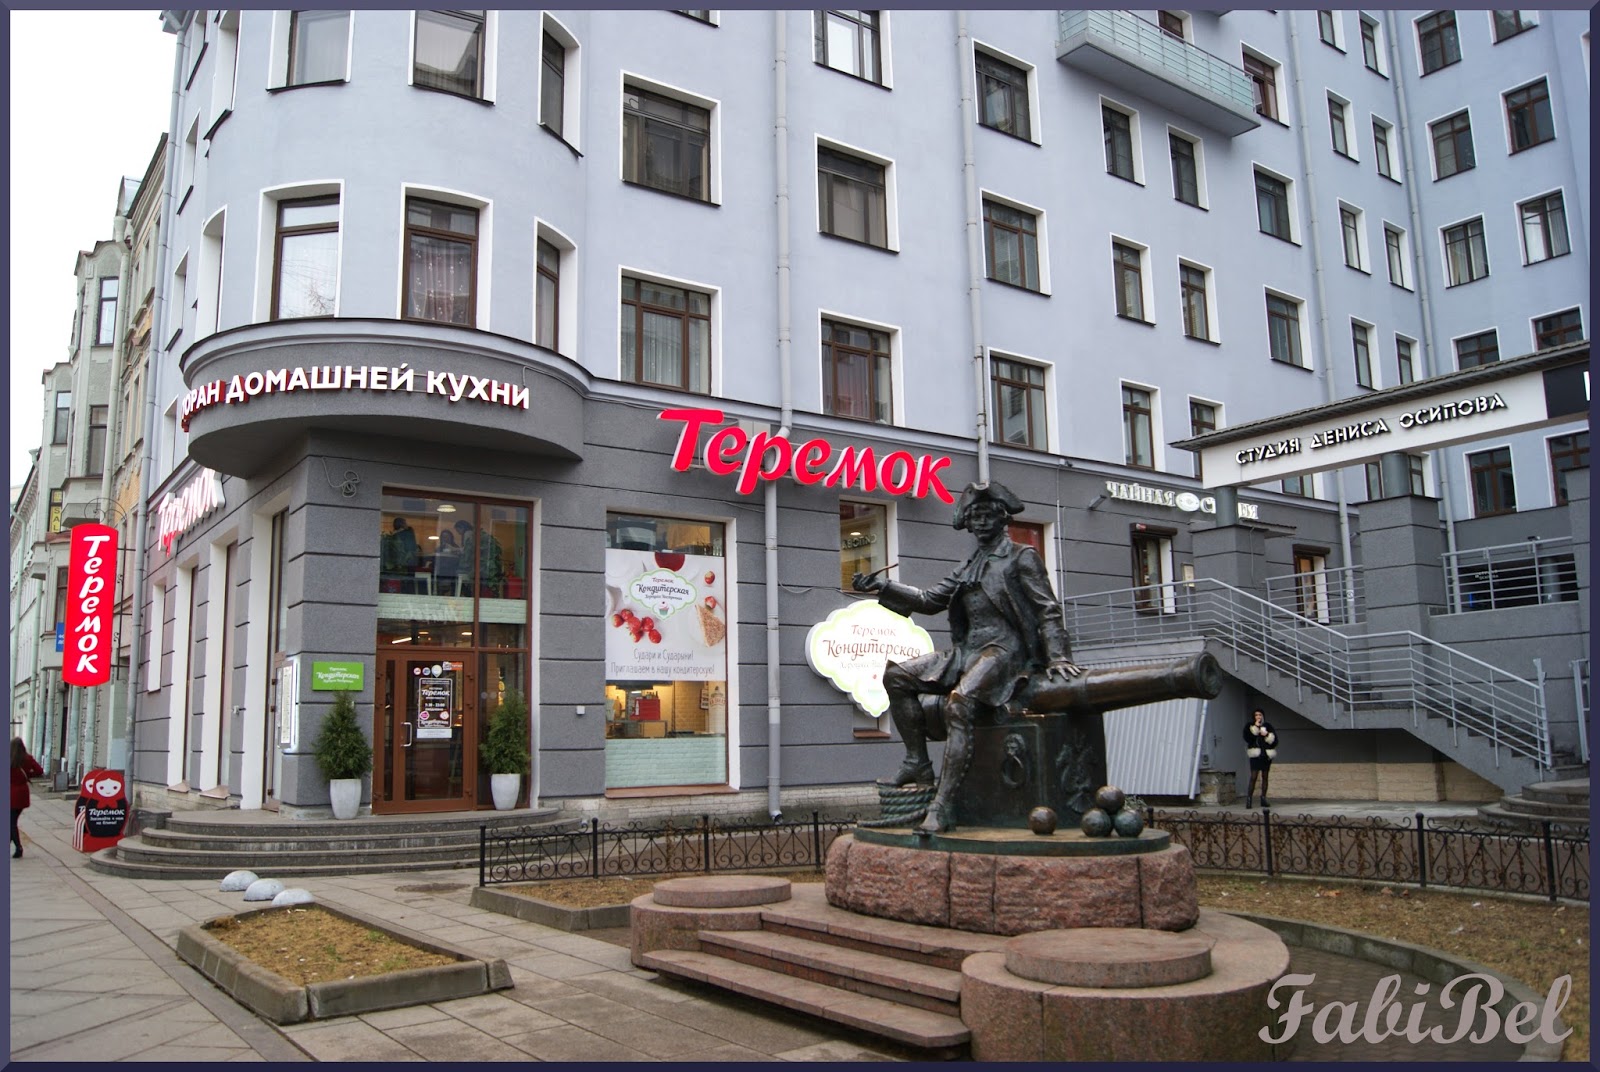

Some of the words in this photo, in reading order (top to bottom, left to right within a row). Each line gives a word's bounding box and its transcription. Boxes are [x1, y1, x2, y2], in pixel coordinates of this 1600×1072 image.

[181, 379, 222, 420] ОРАН
[225, 363, 415, 404] ДОМАШНЕЙ
[426, 370, 530, 410] КУХНИ
[1235, 437, 1301, 465] СТУДИЯ
[1310, 418, 1390, 449] ДЕНИСА
[1399, 393, 1507, 430] ОСИПОВА
[656, 408, 955, 504] Теремок
[1106, 481, 1176, 507] ЧАЙНАЯ
[75, 535, 110, 673] Теремок
[636, 583, 690, 596] Кондитерская
[823, 638, 921, 661] Кондитерская
[89, 808, 125, 817] Теремок
